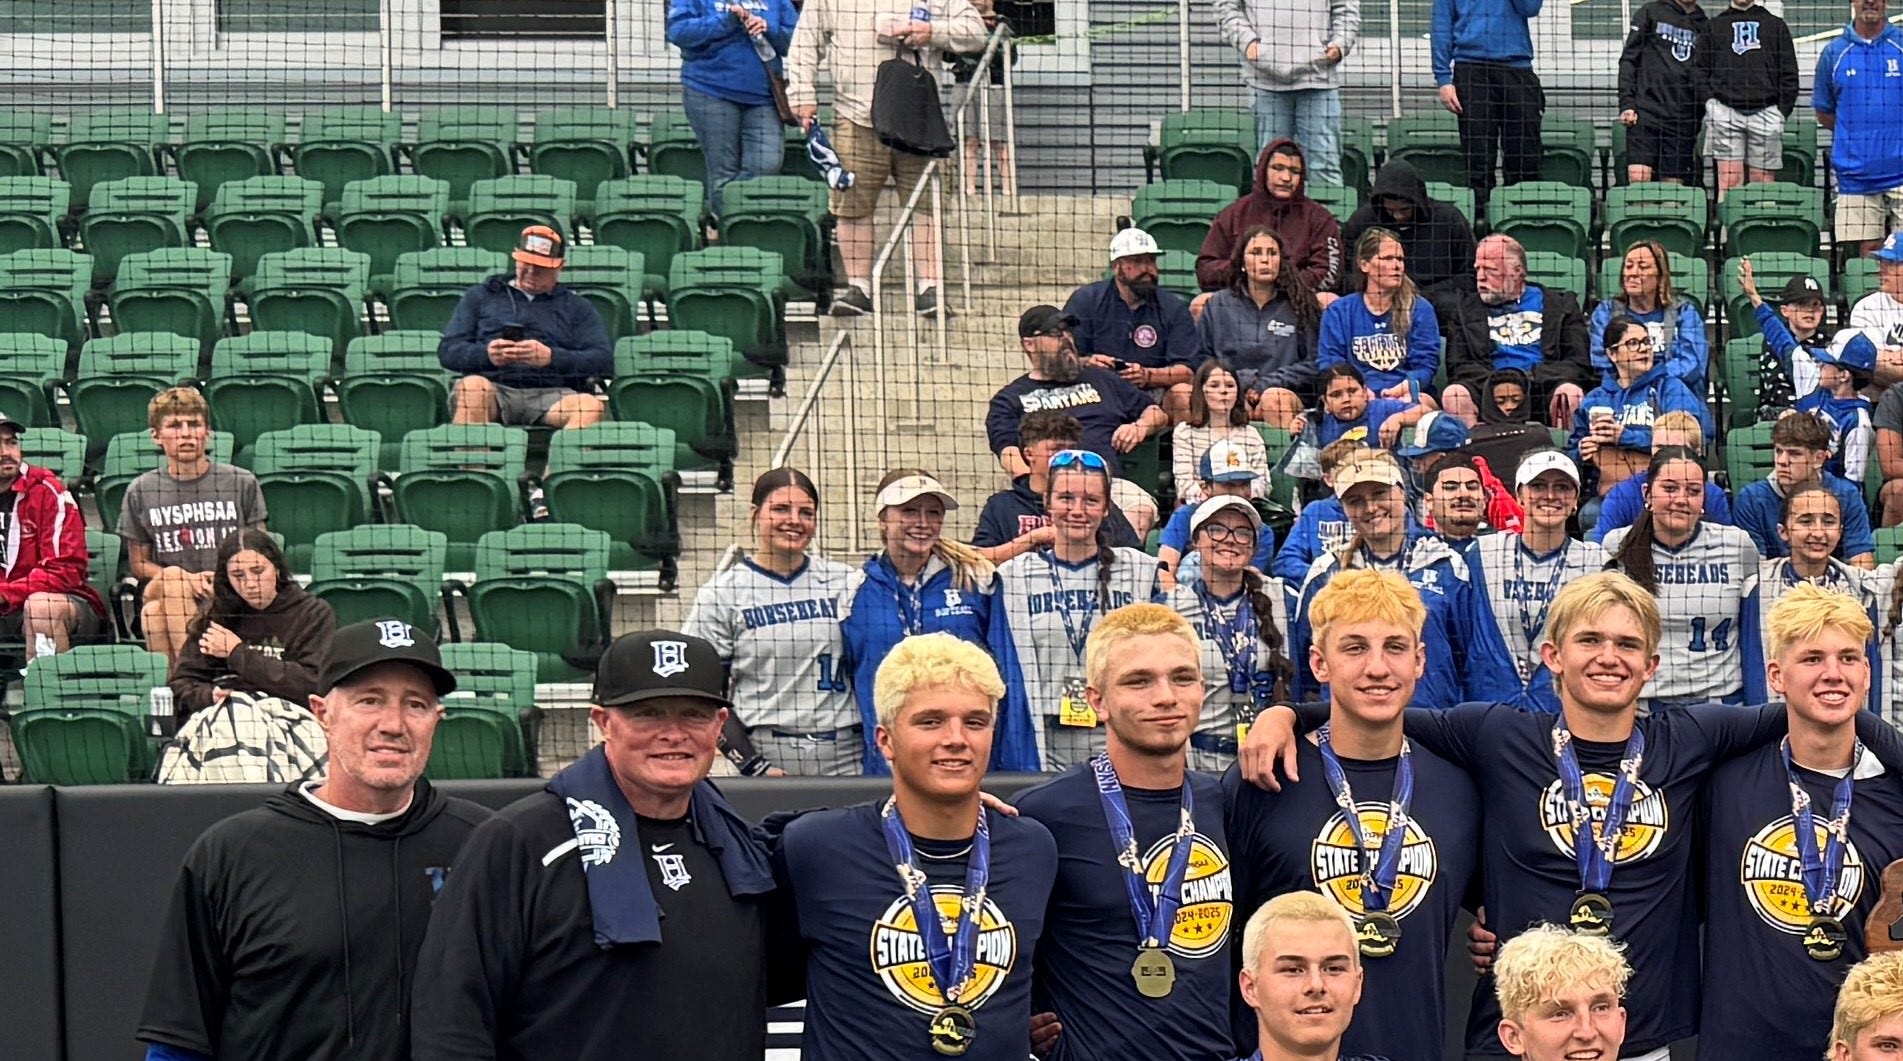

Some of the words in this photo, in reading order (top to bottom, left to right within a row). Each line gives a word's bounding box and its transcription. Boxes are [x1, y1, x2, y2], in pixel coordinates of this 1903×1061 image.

[1732, 21, 1761, 55] H
[149, 501, 237, 526] NYSPHSAA
[1656, 563, 1728, 584] SEHEADS
[742, 597, 838, 629] HORSEHEA
[376, 620, 415, 648] H
[1688, 617, 1731, 652] 14
[650, 641, 690, 677] H
[652, 853, 692, 890] H
[1319, 846, 1359, 878] STATE
[1745, 849, 1786, 878] STATE
[1770, 884, 1806, 898] 2024-2
